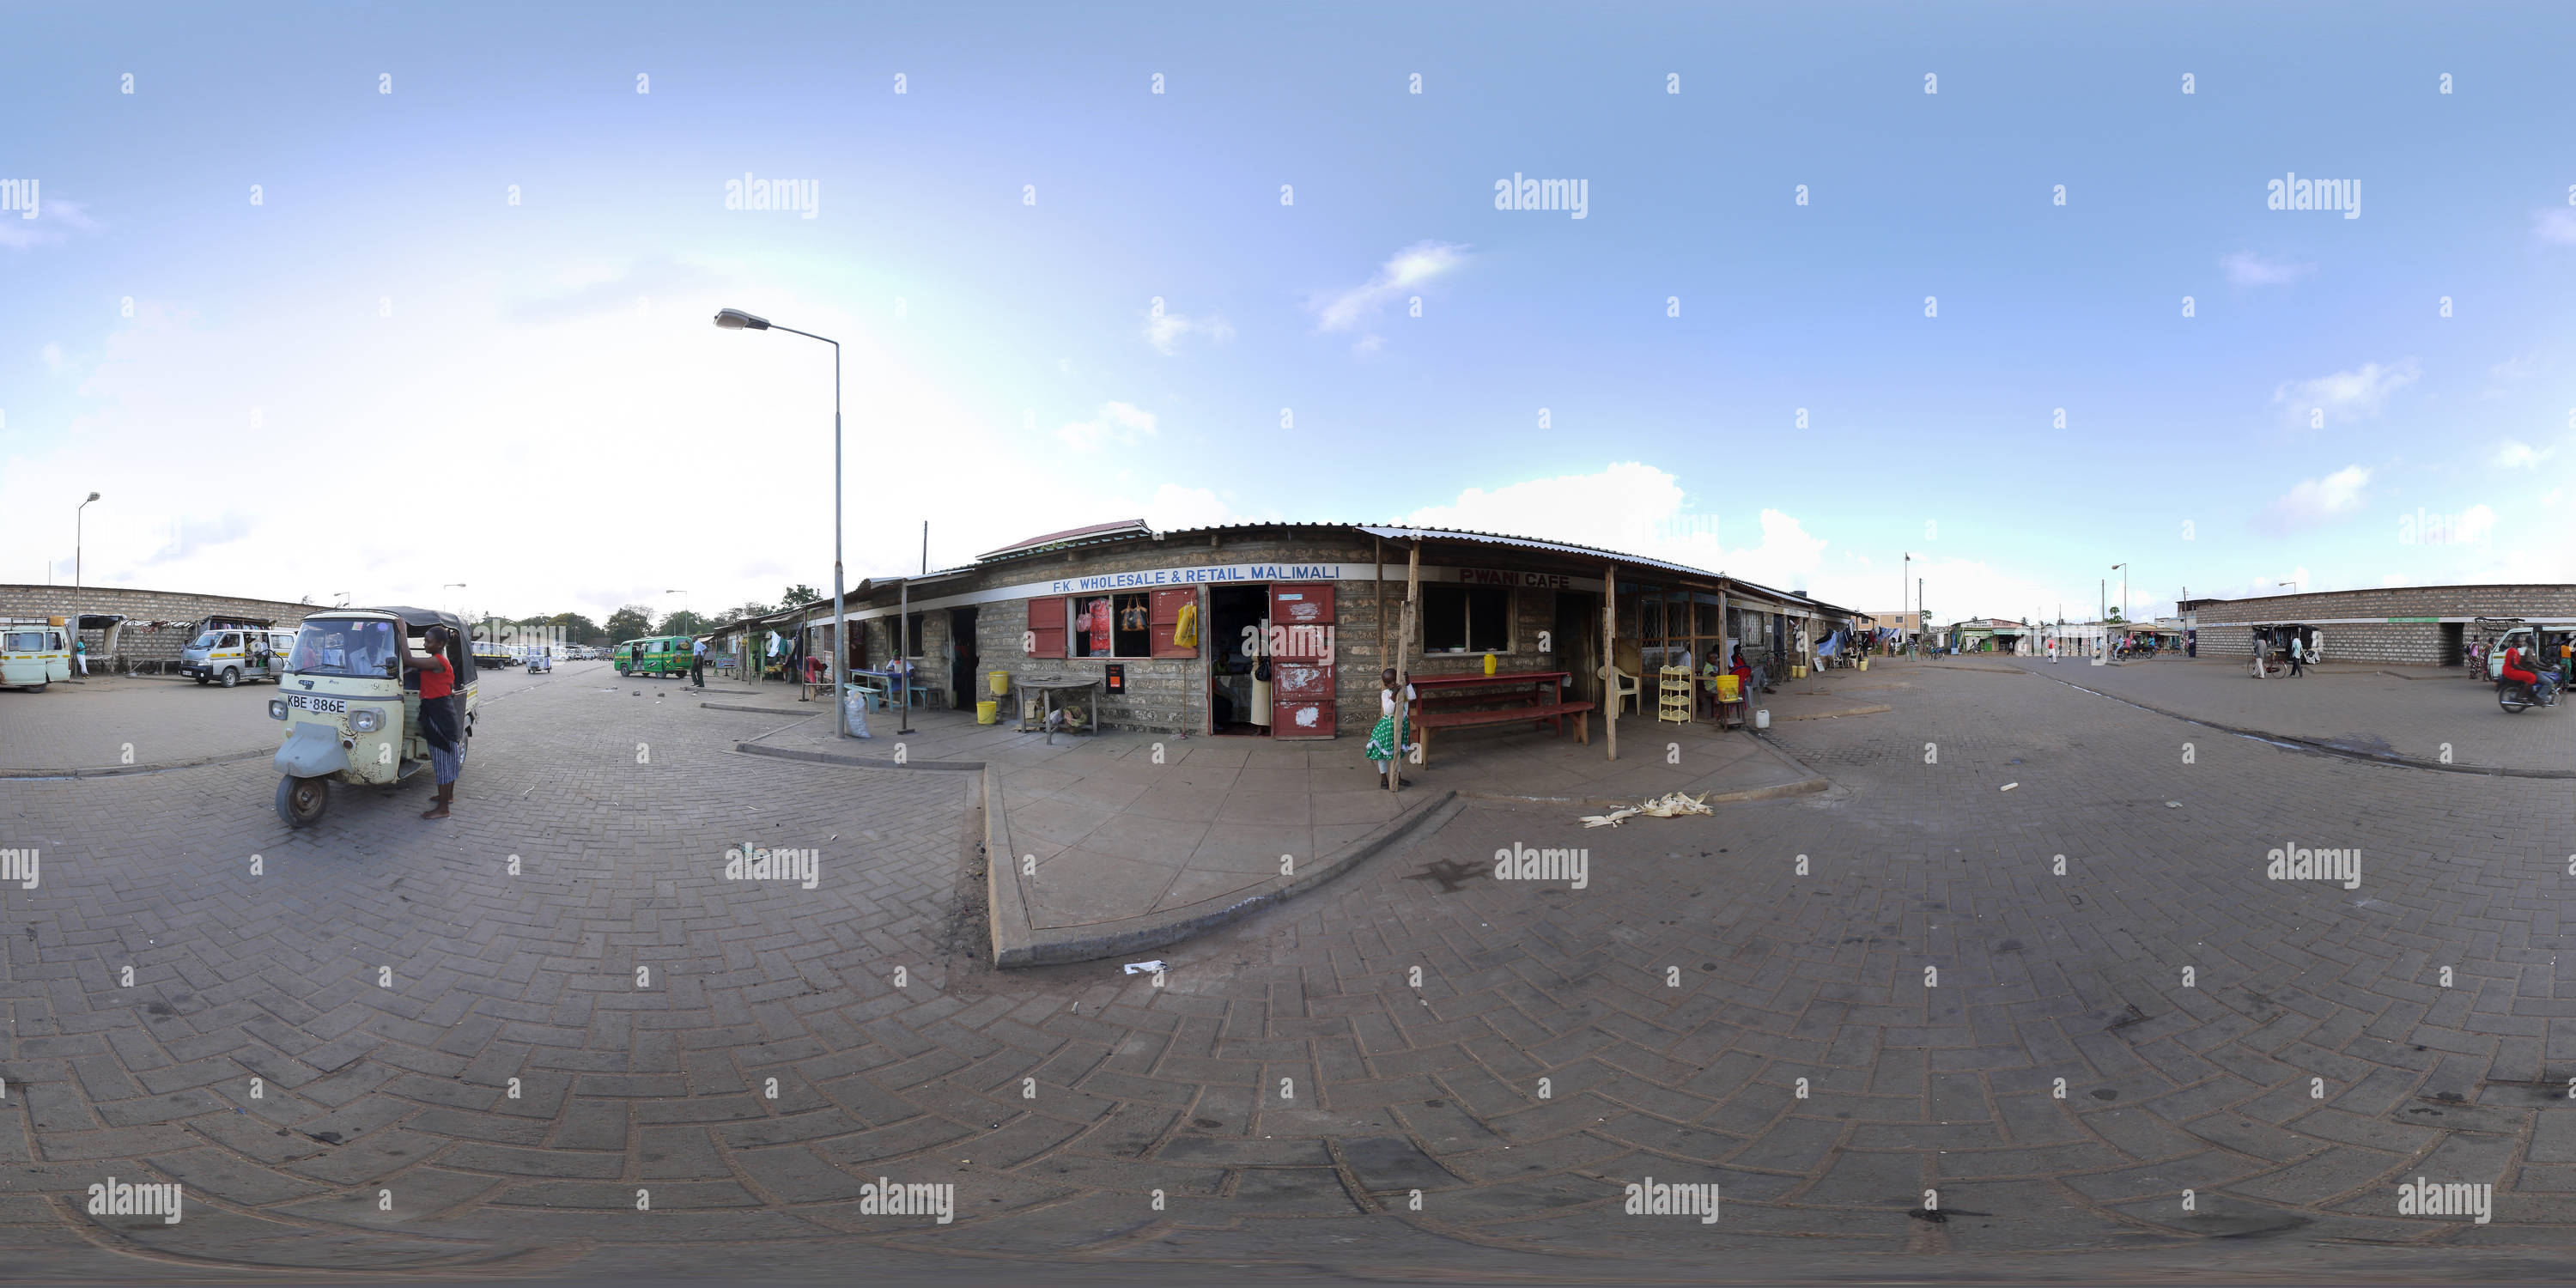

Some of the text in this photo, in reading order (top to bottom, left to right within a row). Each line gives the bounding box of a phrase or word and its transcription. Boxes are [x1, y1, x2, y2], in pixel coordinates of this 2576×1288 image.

[1079, 572, 1166, 590] WHOLESALE
[1171, 570, 1181, 583] &
[1186, 568, 1245, 582] RETAIL
[1251, 566, 1340, 580] MALIMALI
[1460, 568, 1570, 589] PWANI CAFE
[288, 695, 345, 714] KBE 886E
